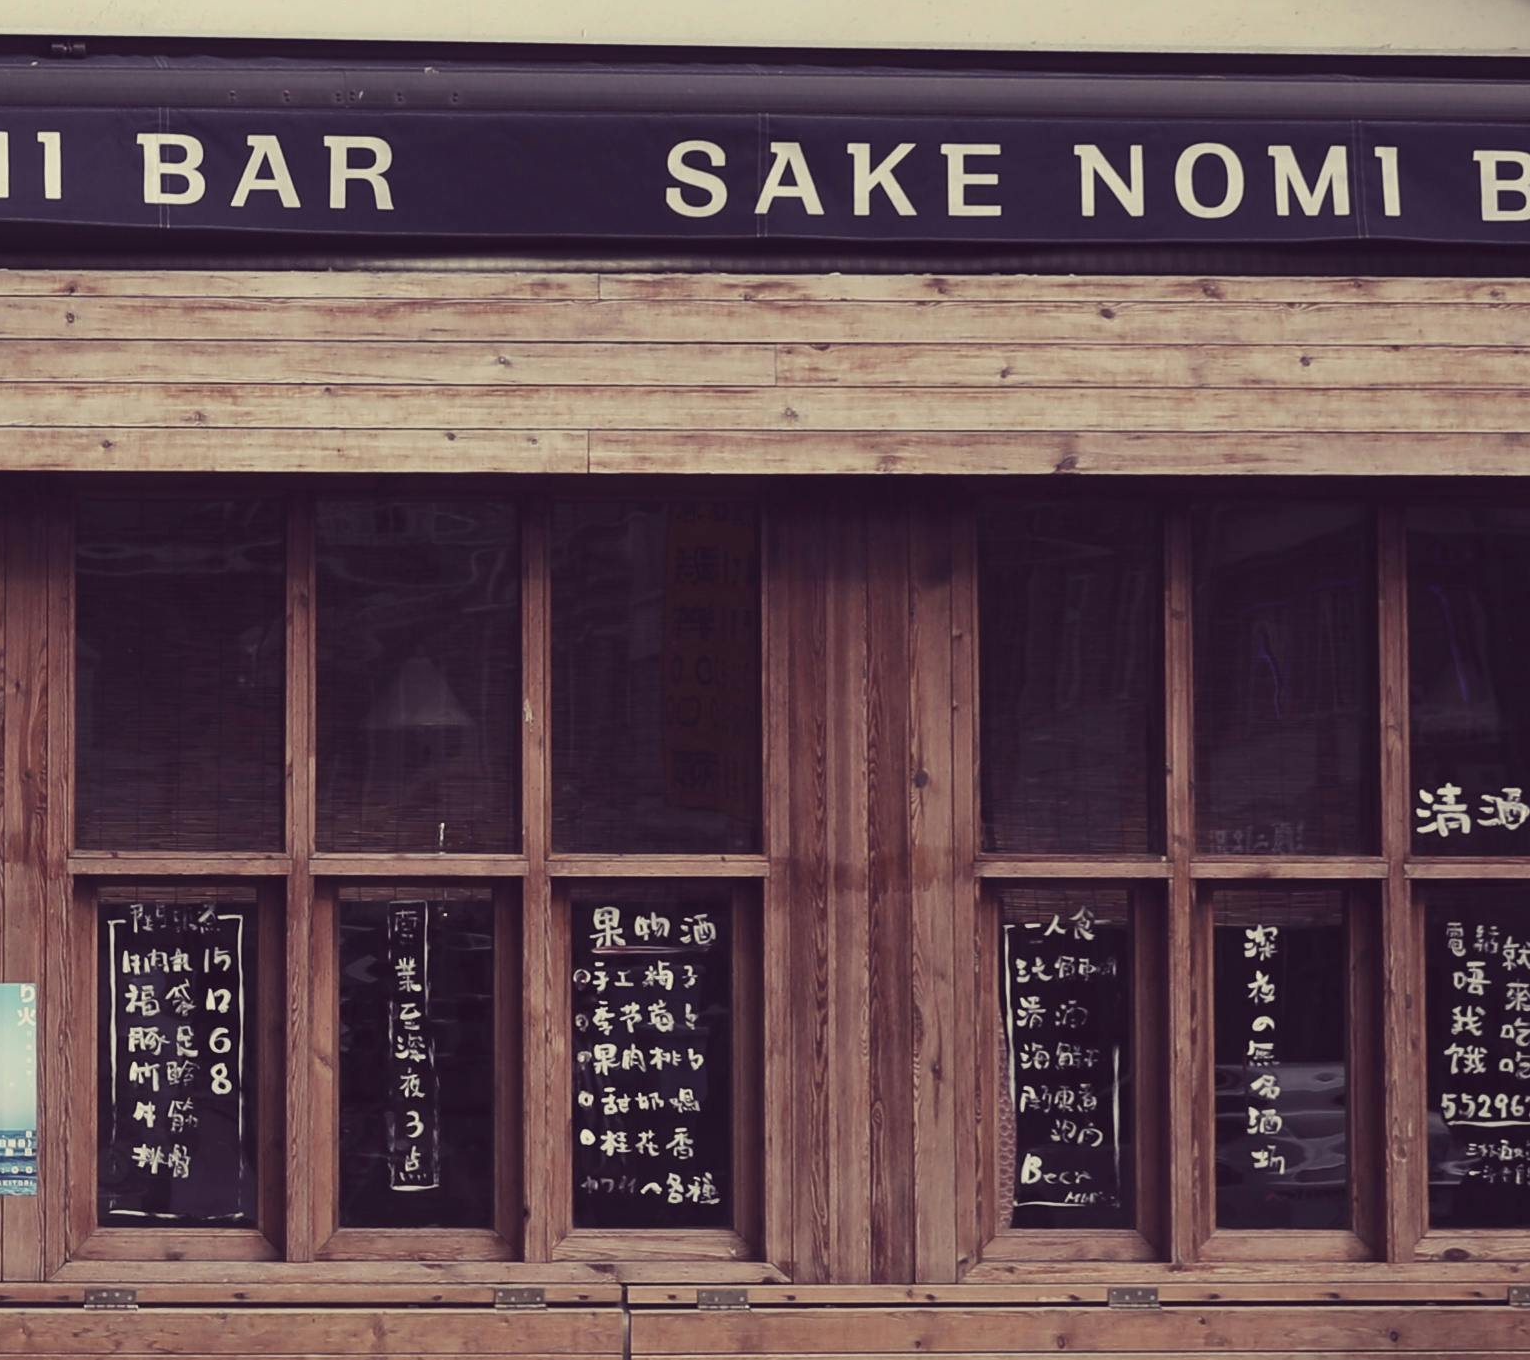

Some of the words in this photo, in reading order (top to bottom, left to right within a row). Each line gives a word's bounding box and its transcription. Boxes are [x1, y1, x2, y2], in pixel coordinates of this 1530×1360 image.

[137, 131, 395, 210] BAR
[665, 140, 1003, 218] SAKE
[1074, 142, 1402, 218] NOMI
[589, 906, 717, 948] 果物酒
[203, 947, 232, 974] 15
[205, 987, 232, 1014] 12
[208, 1026, 232, 1054] 6
[210, 1062, 233, 1095] 8
[599, 1127, 694, 1160] 桂花香
